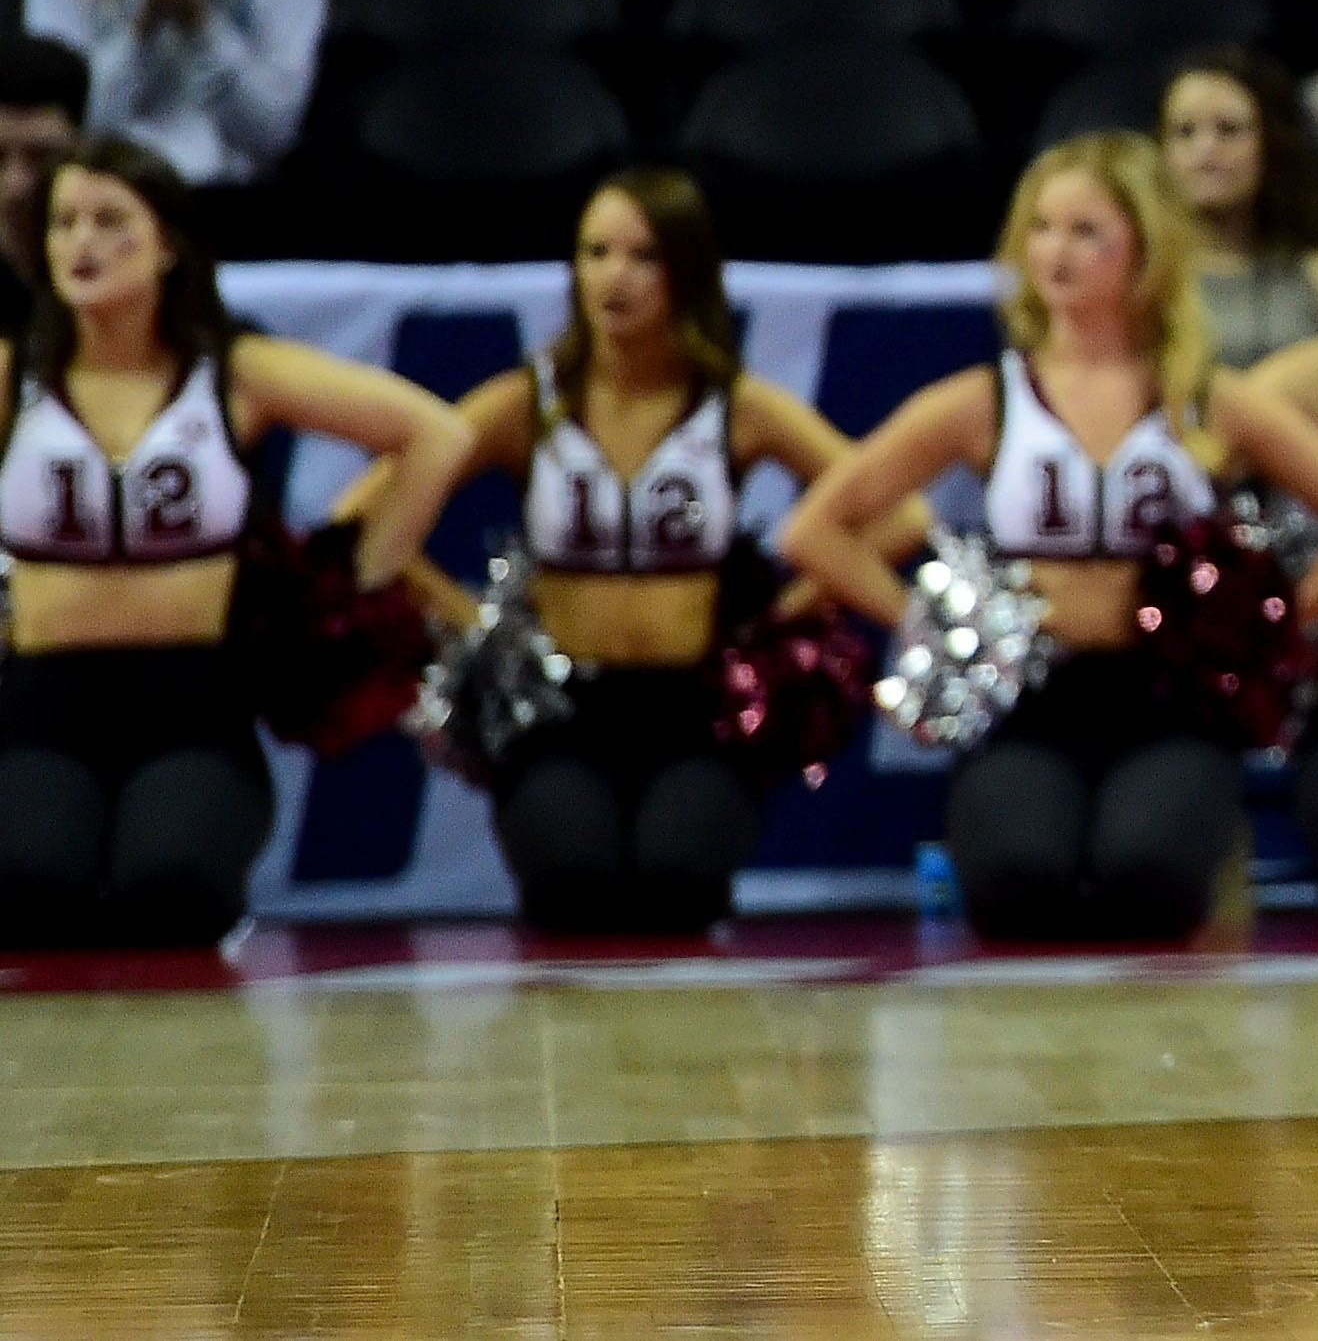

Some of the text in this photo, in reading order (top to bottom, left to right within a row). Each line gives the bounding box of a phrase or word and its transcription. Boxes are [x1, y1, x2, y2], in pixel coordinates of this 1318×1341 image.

[44, 458, 195, 543] 12
[564, 470, 702, 553] 12
[1034, 460, 1178, 539] 12
